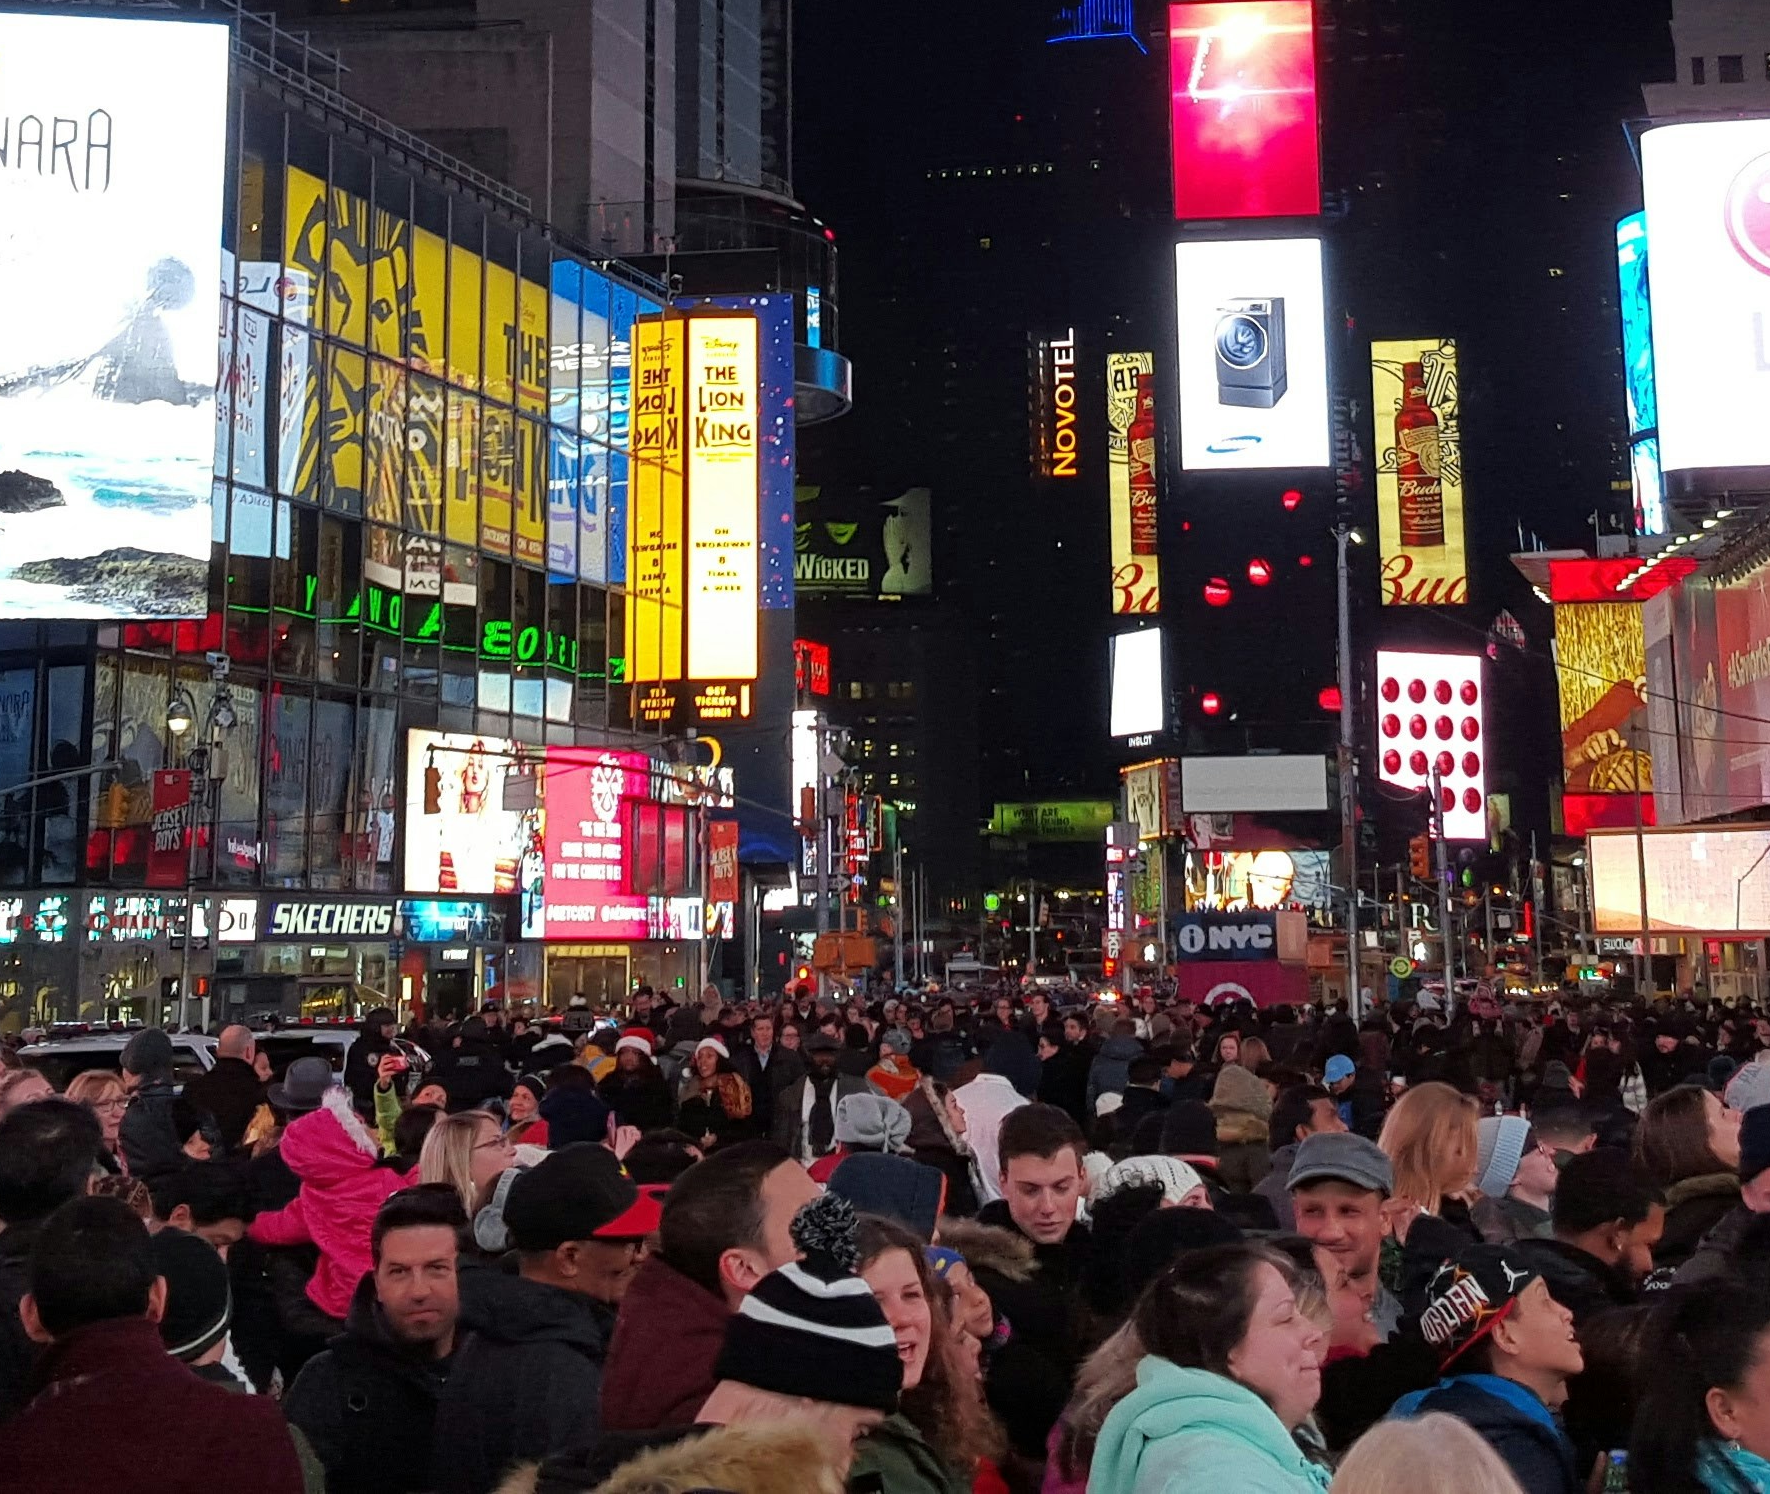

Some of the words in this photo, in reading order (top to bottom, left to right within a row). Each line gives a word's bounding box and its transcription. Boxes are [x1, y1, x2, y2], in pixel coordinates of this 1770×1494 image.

[705, 367, 736, 381] THE
[699, 387, 744, 412] LION
[1052, 327, 1077, 477] NOVOTEL
[696, 417, 751, 446] KING
[794, 553, 869, 580] WICKED
[150, 806, 189, 836] JERSEY
[153, 824, 182, 853] BOYS
[273, 903, 392, 935] SKECHERS
[1208, 924, 1273, 950] NYC
